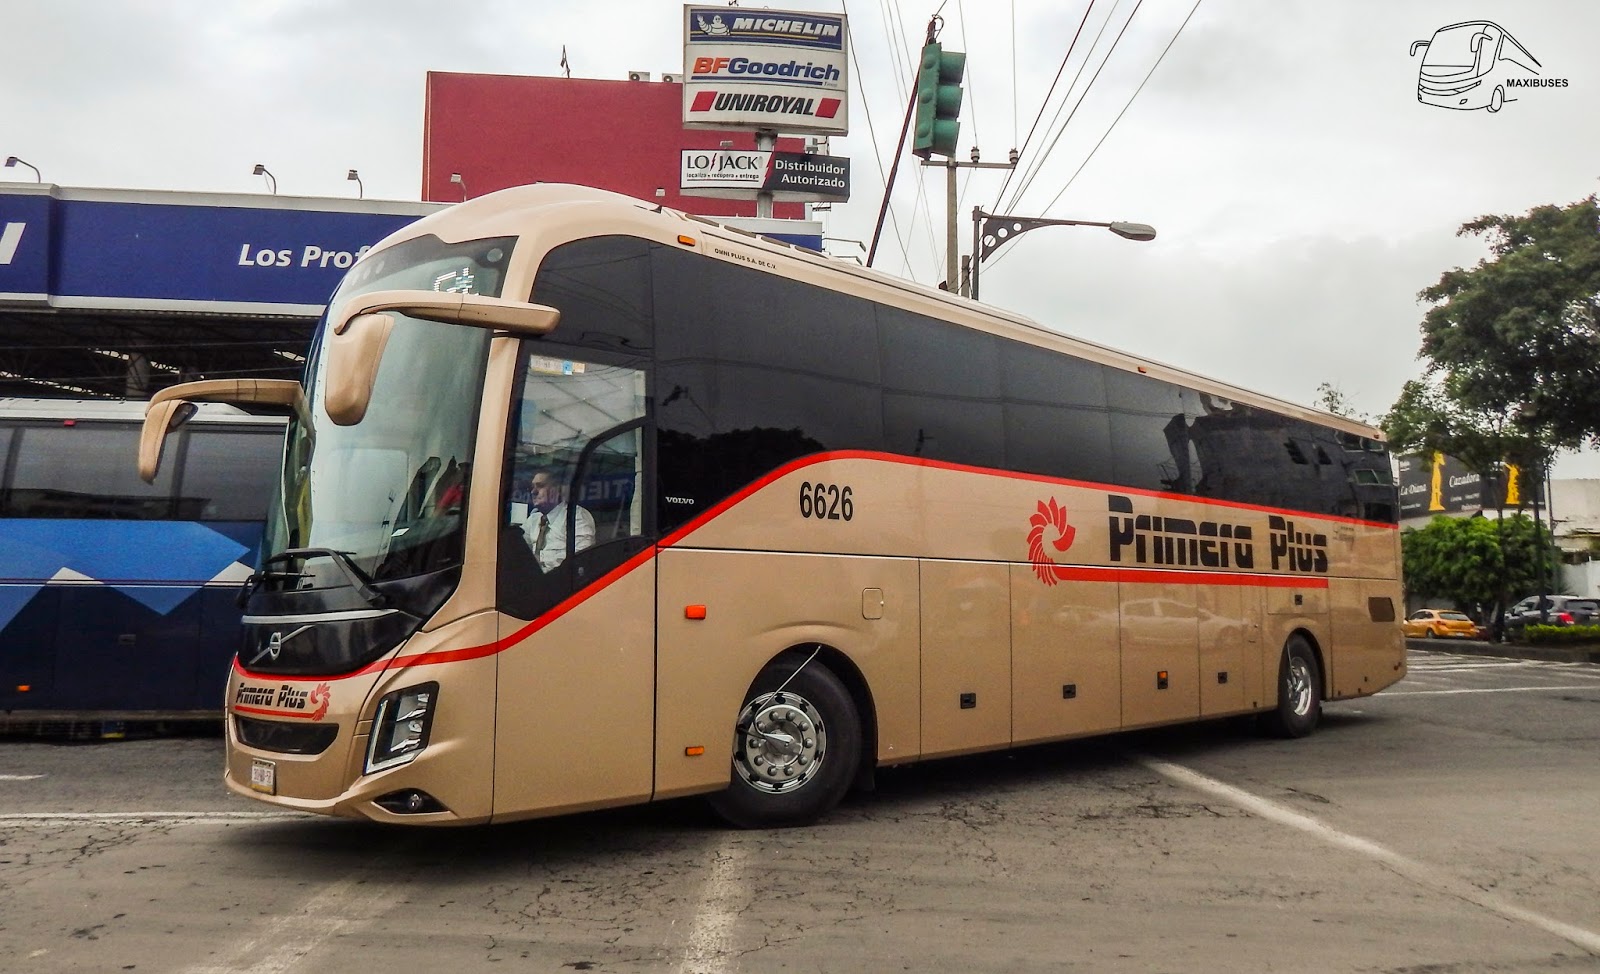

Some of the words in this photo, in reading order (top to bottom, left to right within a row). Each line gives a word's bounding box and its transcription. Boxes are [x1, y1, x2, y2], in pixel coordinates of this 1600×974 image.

[732, 17, 839, 37] MICHELIN
[693, 57, 840, 81] BFGoodrich
[714, 92, 814, 116] UNIROYAL
[775, 160, 846, 175] Distribuidor
[781, 173, 845, 188] Autorizado
[238, 243, 293, 267] Los
[714, 248, 730, 257] OMNI
[731, 252, 746, 261] PLUS
[665, 496, 695, 505] VOLVO
[799, 481, 854, 522] 6626
[1107, 494, 1254, 569] Primera
[1268, 514, 1328, 573] Plus
[235, 682, 275, 706] Primera
[277, 684, 309, 709] Plus
